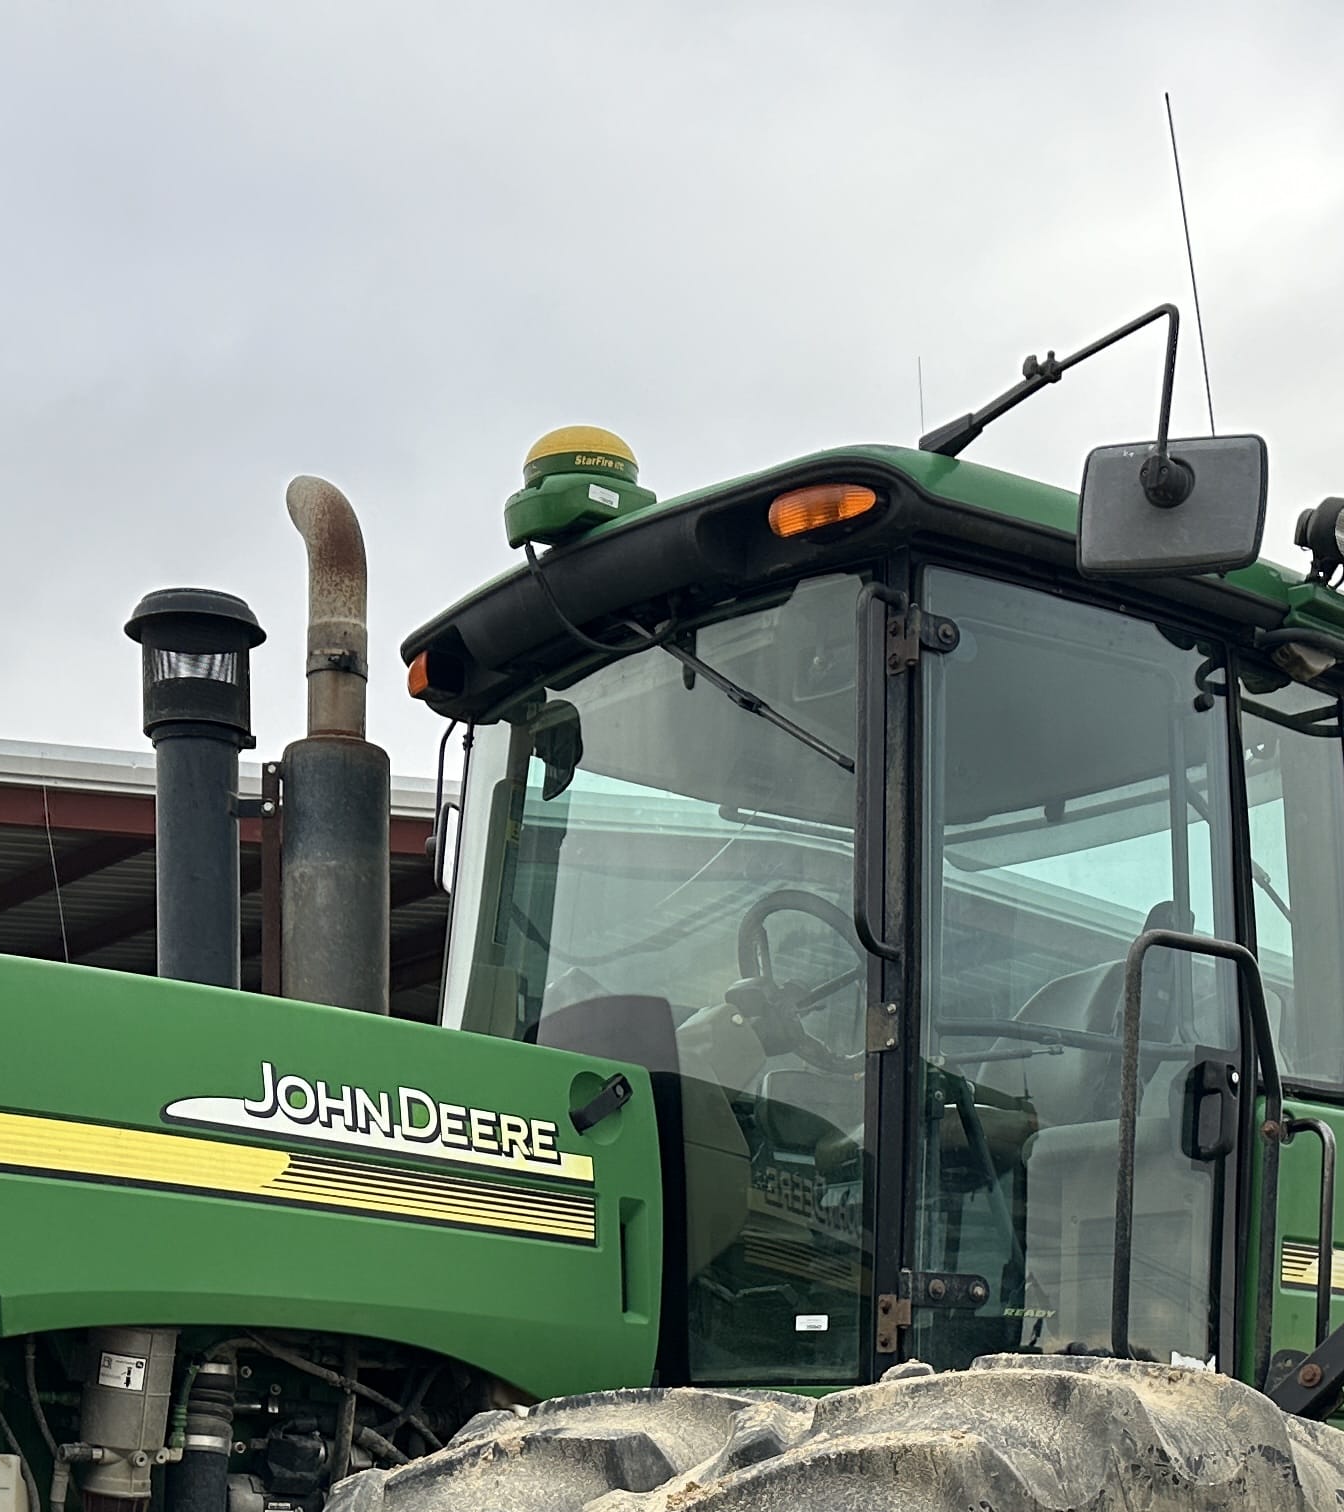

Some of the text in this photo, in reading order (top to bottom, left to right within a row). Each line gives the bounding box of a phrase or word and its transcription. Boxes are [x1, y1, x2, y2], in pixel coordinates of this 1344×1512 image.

[574, 455, 614, 467] StarFire
[244, 1061, 560, 1164] JOHN DEERE
[1003, 1307, 1056, 1318] READY
